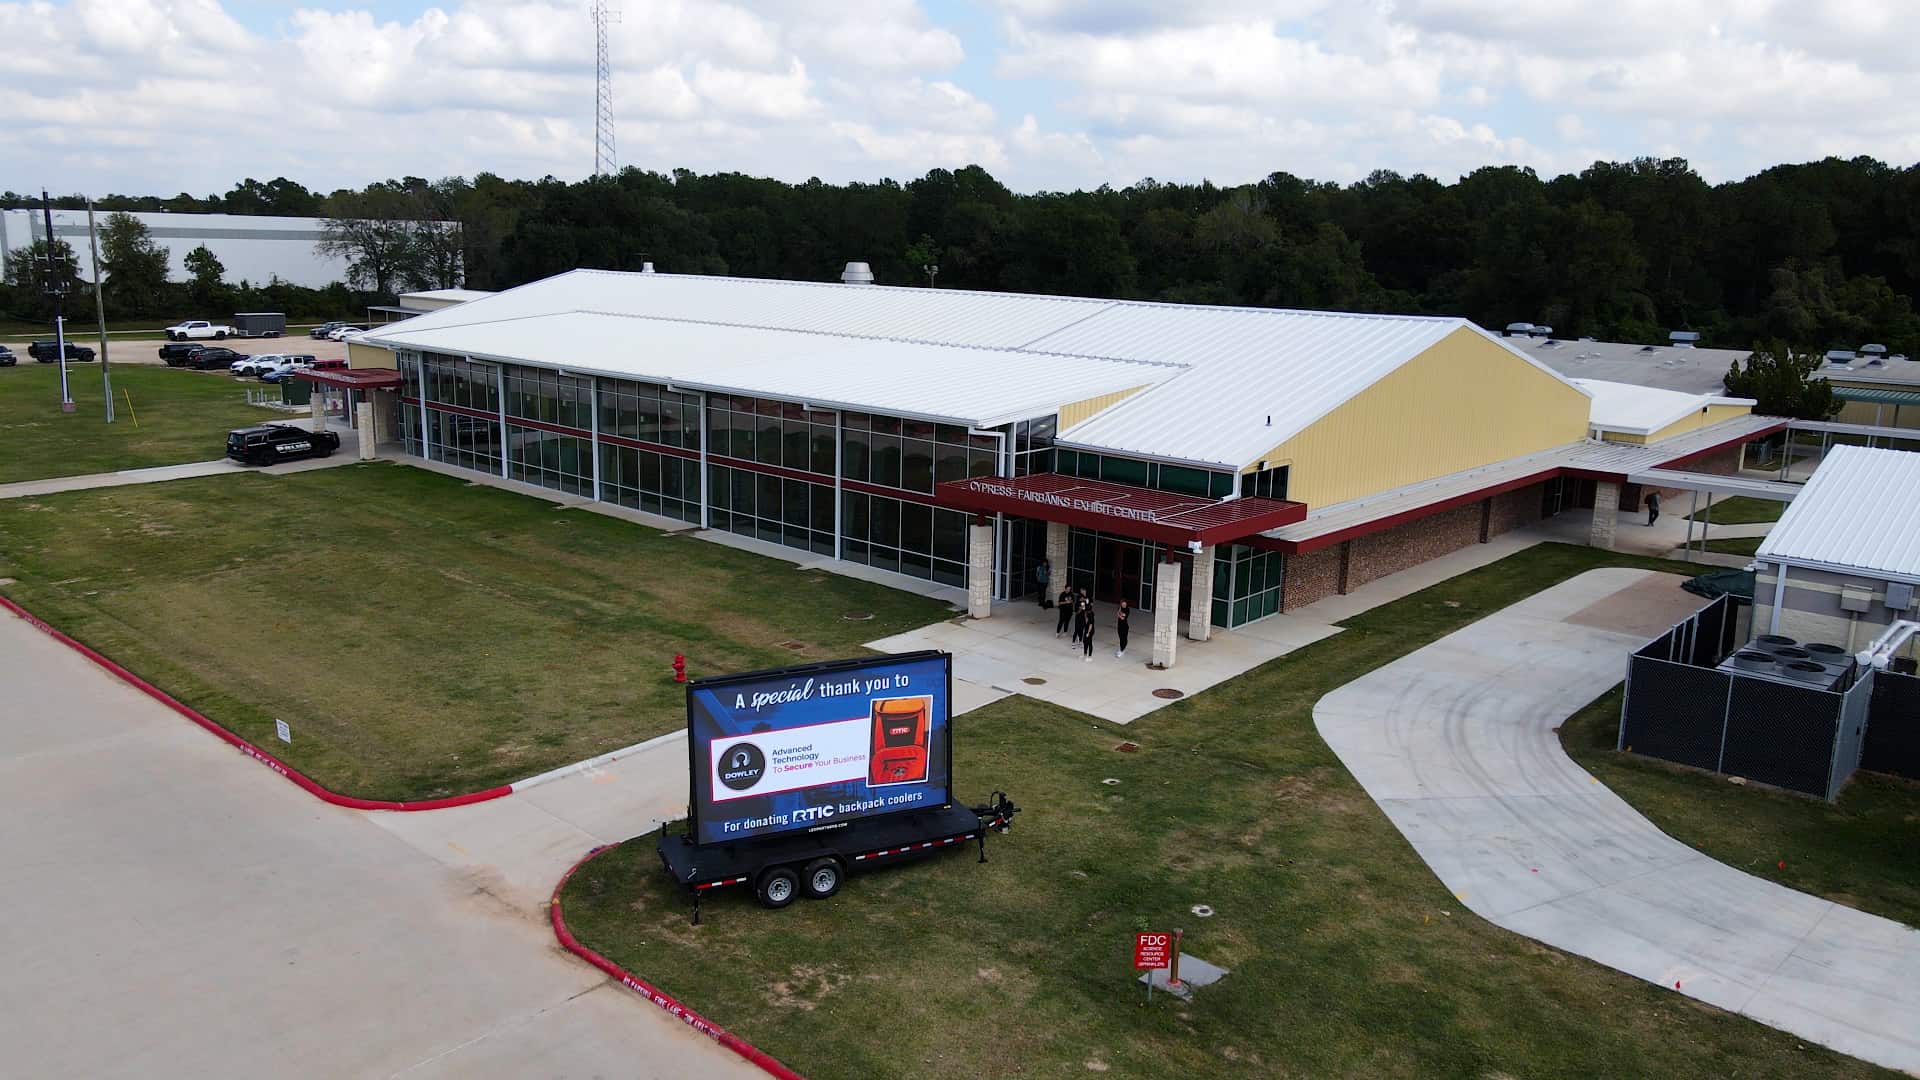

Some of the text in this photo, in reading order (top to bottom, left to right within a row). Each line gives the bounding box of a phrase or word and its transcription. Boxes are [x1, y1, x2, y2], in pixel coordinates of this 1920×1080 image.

[1073, 499, 1112, 515] EXHIBIT
[1113, 506, 1157, 523] CENTER
[735, 673, 909, 712] A special thank you to
[772, 744, 812, 756] Advanced
[772, 753, 820, 765] Technology
[773, 754, 866, 774] To Secure Your Business
[724, 769, 761, 780] DOWLEY
[724, 791, 923, 833] For donating RTIC backpack coolers
[1140, 935, 1167, 946] FDC
